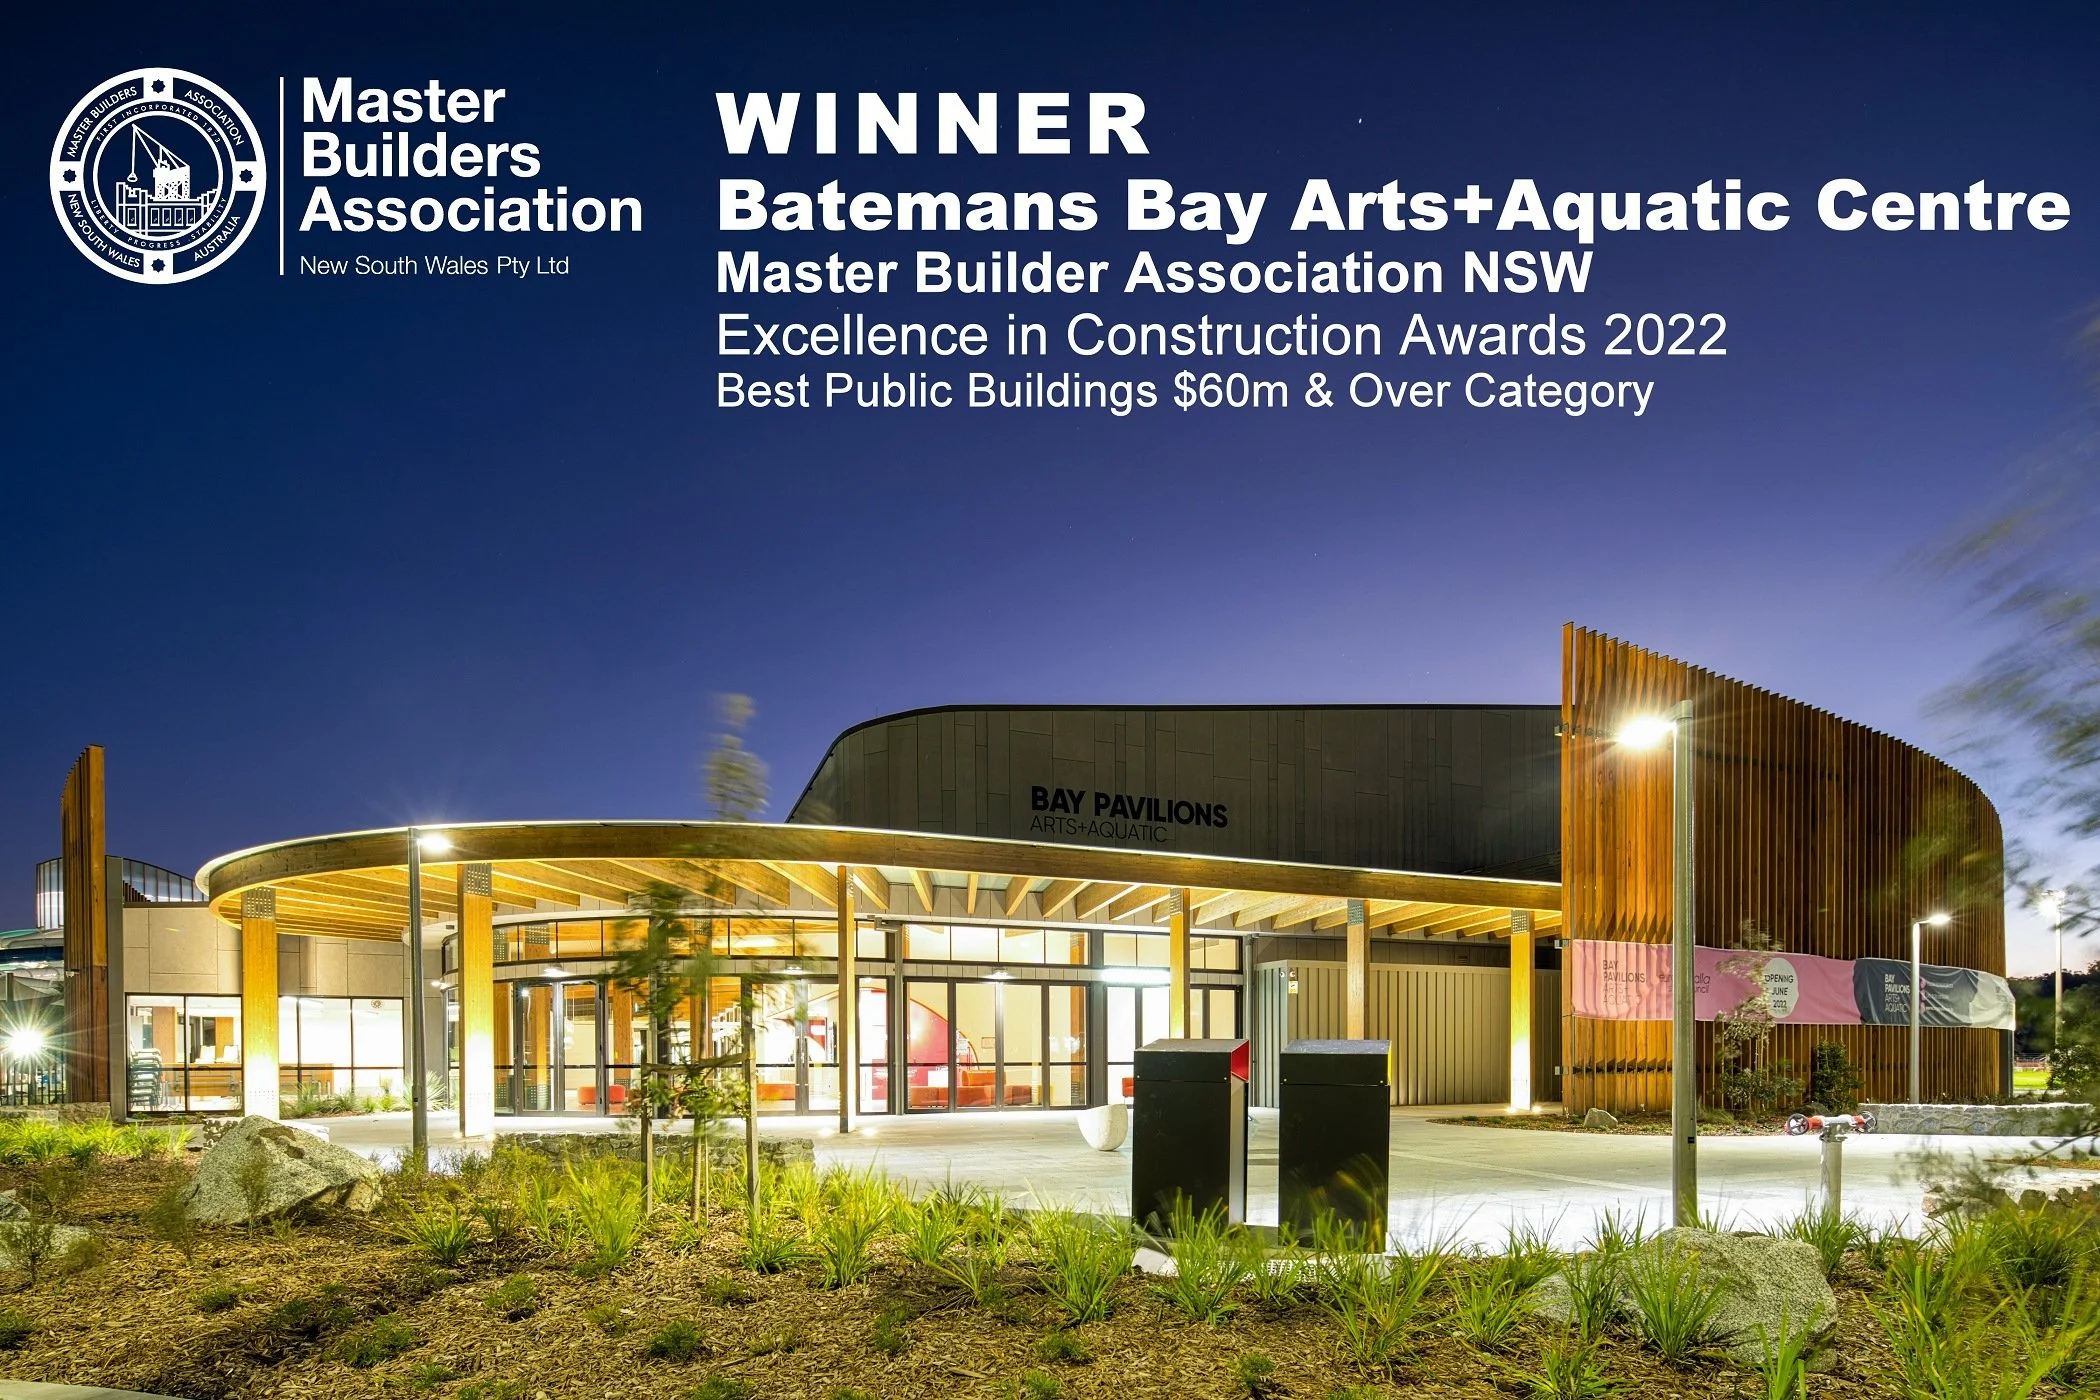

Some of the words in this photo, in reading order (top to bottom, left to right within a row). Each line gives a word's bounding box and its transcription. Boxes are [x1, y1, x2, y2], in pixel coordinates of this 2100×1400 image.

[1031, 785, 1086, 814] BAY
[1094, 791, 1228, 828] PAVILIONS
[1030, 815, 1169, 843] ARTS+AQUATIC
[1603, 960, 1618, 970] BAY
[1603, 971, 1646, 983] PAVILIONS
[1765, 974, 1794, 983] OPENING
[1885, 974, 1896, 983] BAY
[1771, 987, 1789, 996] JUNE
[1884, 983, 1910, 994] PAVILIONS
[1772, 1000, 1788, 1008] 2022
